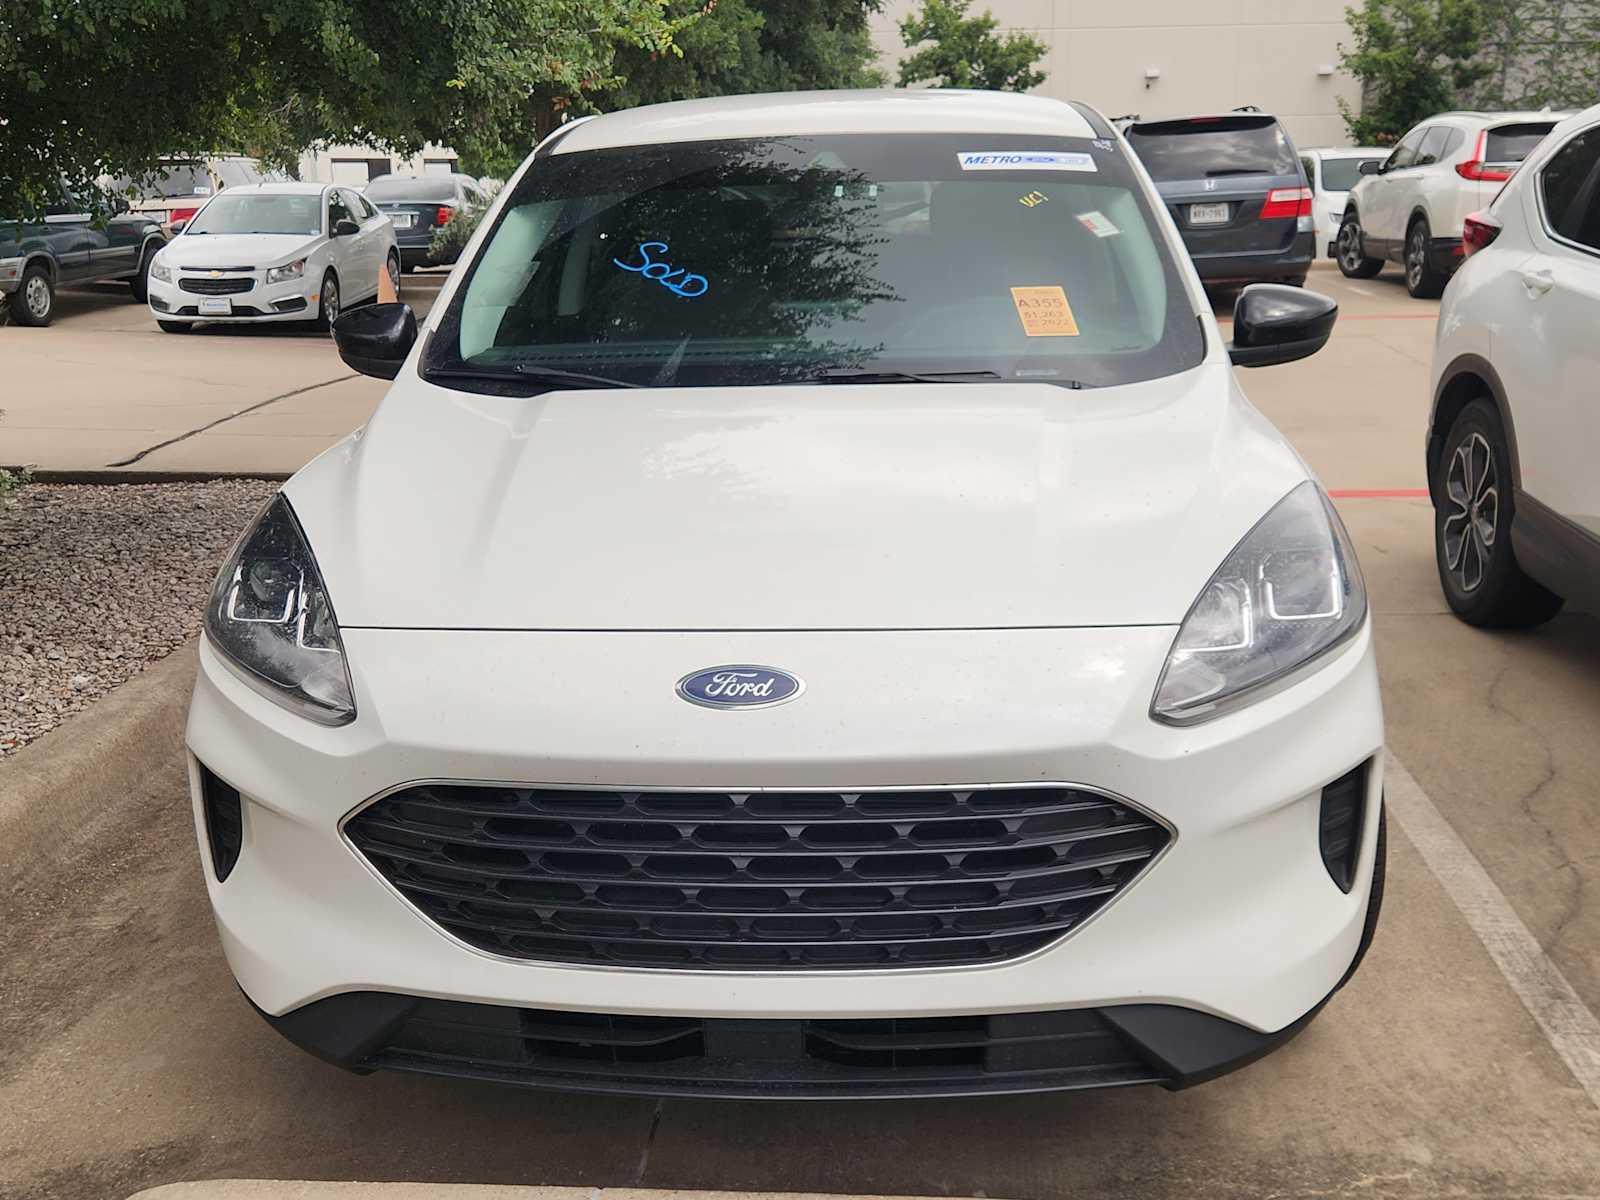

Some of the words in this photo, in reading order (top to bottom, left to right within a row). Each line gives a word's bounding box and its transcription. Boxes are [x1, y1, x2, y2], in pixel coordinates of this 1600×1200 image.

[964, 155, 1022, 165] METRO
[1018, 298, 1064, 308] A355
[704, 671, 776, 697] Ford
